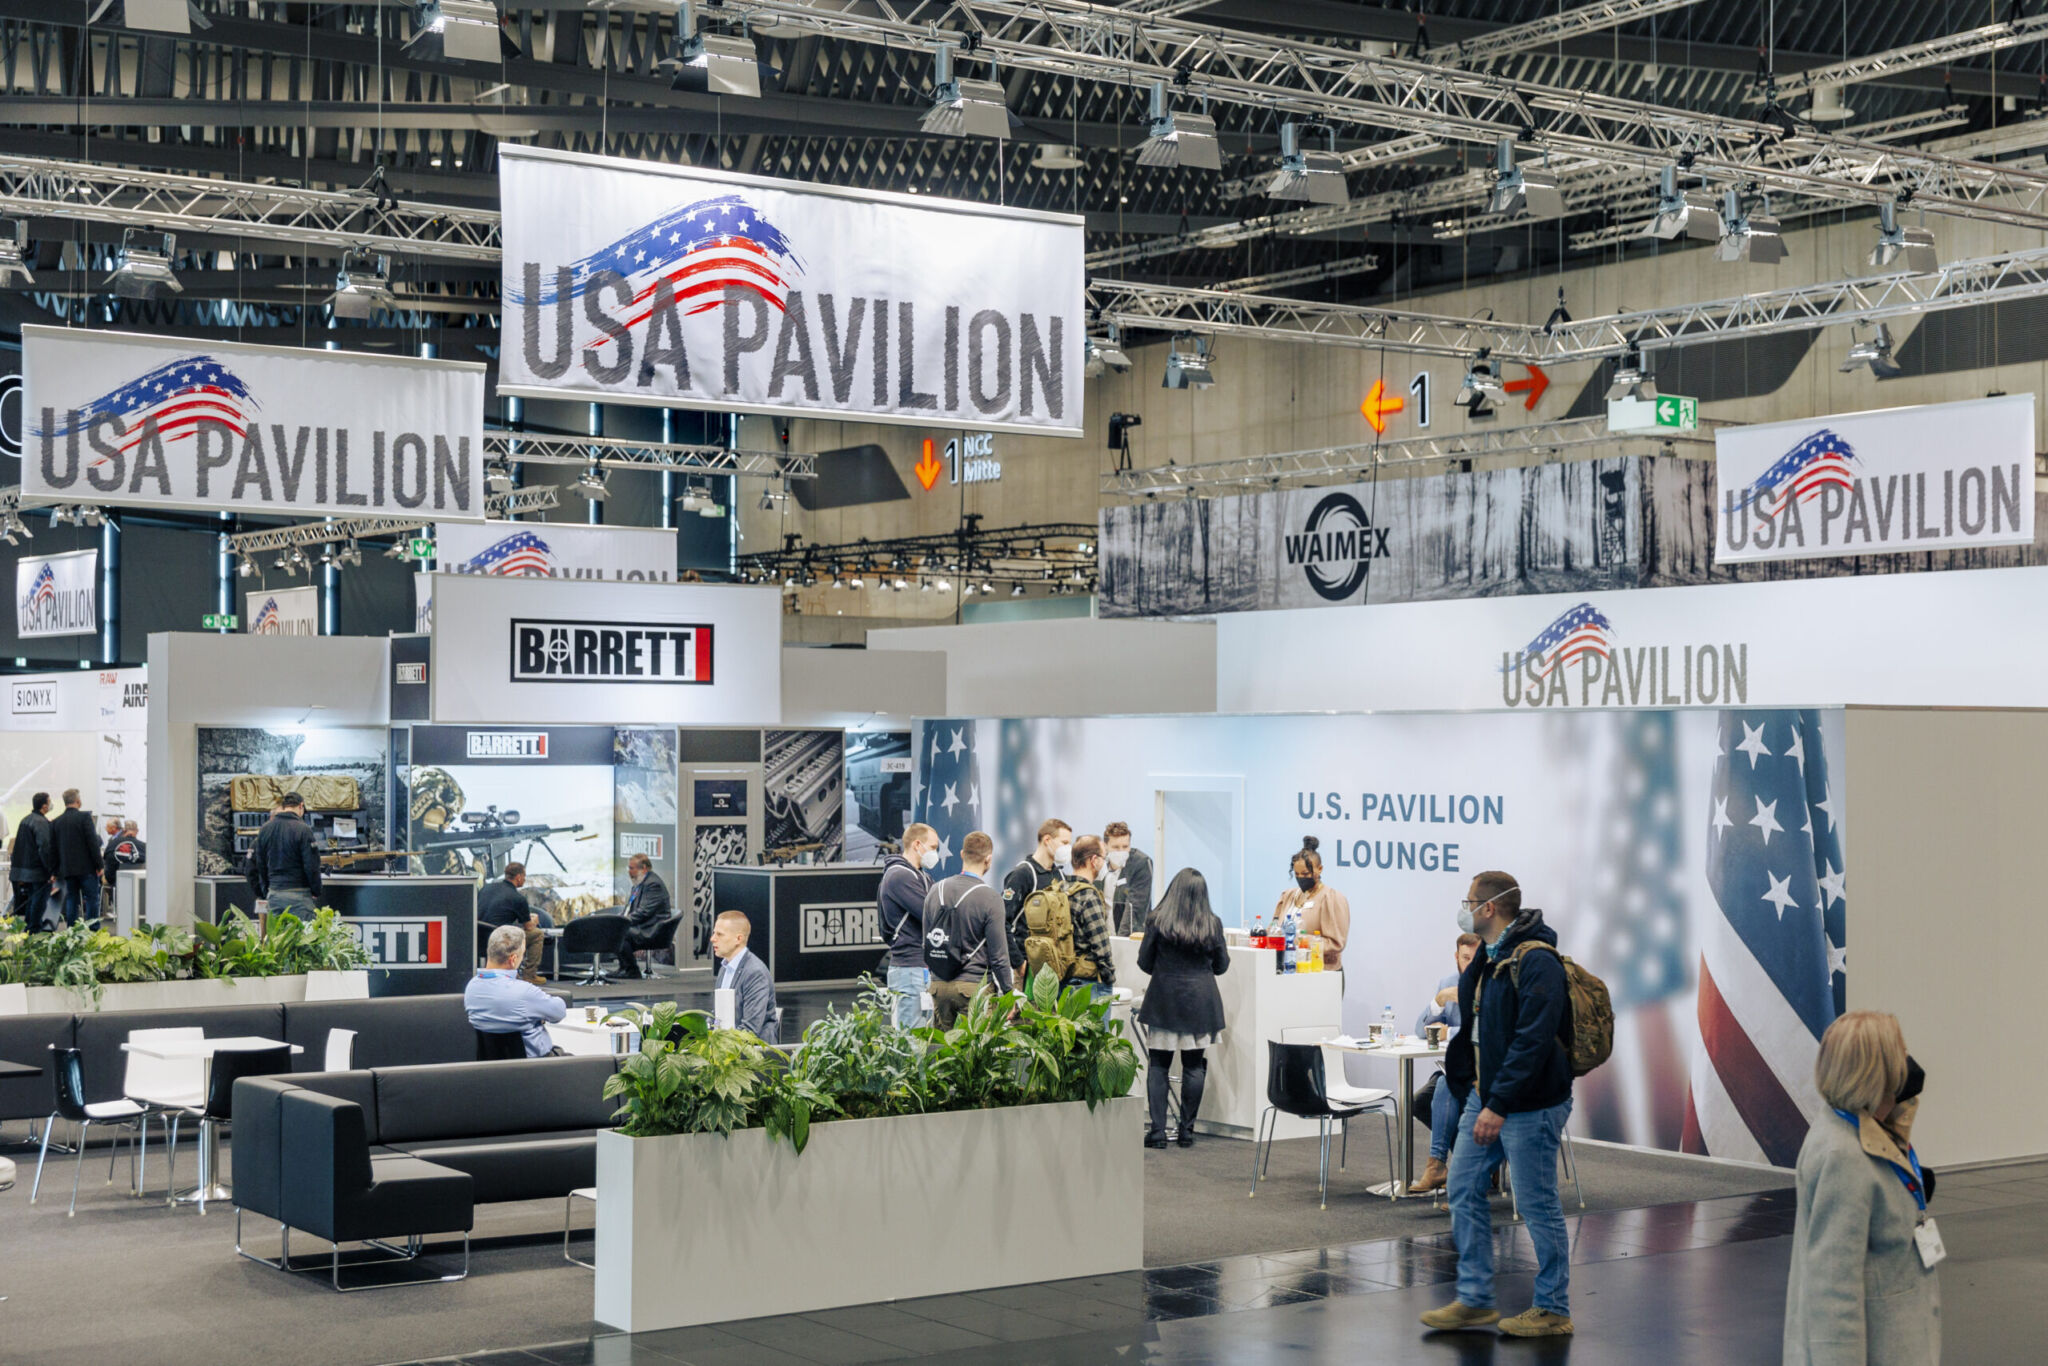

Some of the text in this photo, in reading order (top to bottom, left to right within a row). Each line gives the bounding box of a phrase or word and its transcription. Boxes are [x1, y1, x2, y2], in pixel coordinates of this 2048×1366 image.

[521, 262, 1065, 419] USA PAVILION
[1408, 370, 1430, 428] 1
[41, 406, 172, 496] USA
[196, 418, 470, 511] PAVILION
[944, 438, 959, 485] 1
[964, 433, 993, 458] NCC
[964, 460, 1001, 483] Mitte
[1725, 463, 2021, 552] USA PAVILION
[1285, 526, 1391, 564] WAIMEX
[23, 588, 94, 631] USA PAVILION
[519, 627, 692, 677] BARRETT
[1503, 643, 1748, 707] USA PAVILION
[17, 689, 52, 706] SIONYX
[471, 735, 539, 755] BARRETT
[1298, 791, 1504, 824] U.S. PAVILION
[1336, 840, 1460, 872] LOUNGE
